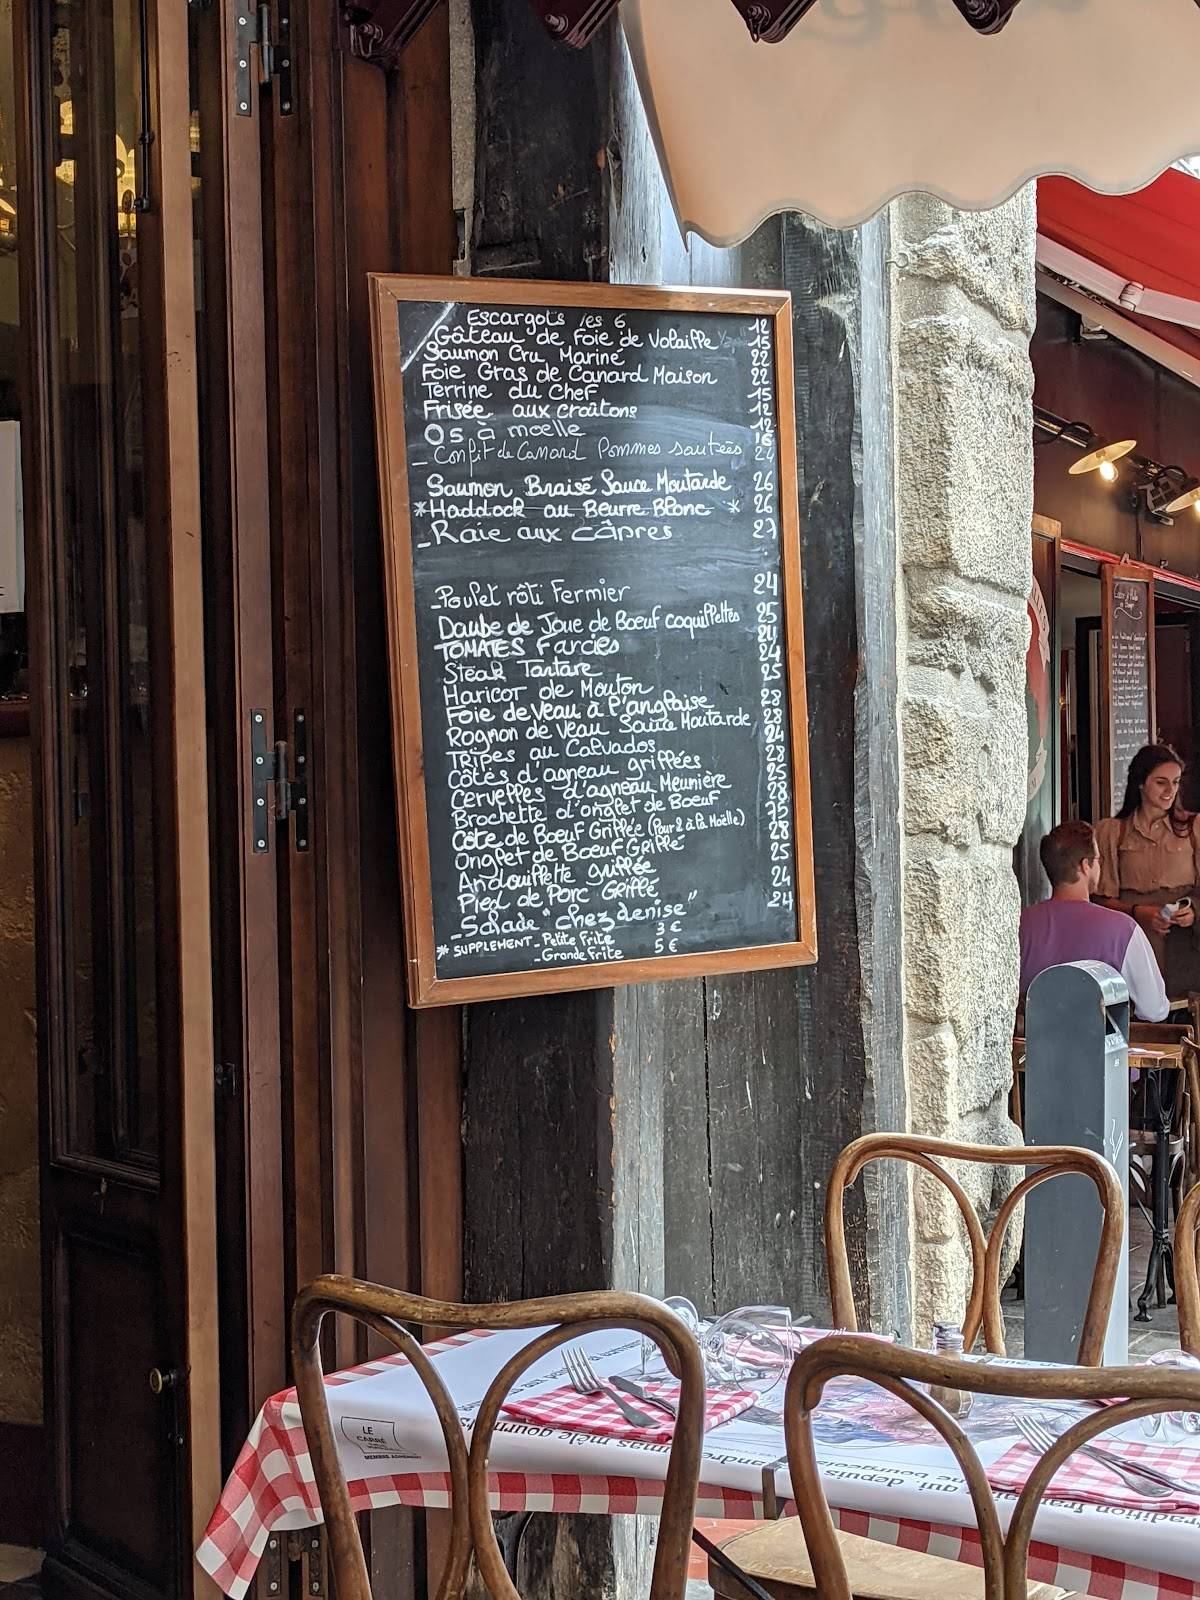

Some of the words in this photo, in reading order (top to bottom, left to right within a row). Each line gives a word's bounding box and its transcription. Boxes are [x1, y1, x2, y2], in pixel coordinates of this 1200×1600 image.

[467, 309, 565, 335] Escargots
[614, 313, 626, 329] 6
[748, 318, 770, 334] 12
[434, 325, 525, 346] Gâteau
[536, 327, 565, 346] de
[574, 328, 614, 346] Foie
[619, 328, 644, 348] de
[748, 335, 771, 349] 15
[423, 341, 499, 361] Saumon
[509, 344, 546, 363] Cru
[559, 345, 626, 366] Mariné
[750, 350, 770, 367] 22
[422, 363, 466, 381] Foie
[477, 362, 528, 381] Gras
[536, 362, 562, 383] de
[568, 363, 650, 384] Canard
[653, 365, 718, 385] Maison
[750, 367, 770, 385] 22
[422, 381, 492, 399] Terrine
[508, 381, 542, 400] du
[747, 387, 772, 401] 15
[423, 400, 494, 420] Frisée
[512, 403, 550, 419] aux
[556, 398, 638, 419] croûtons
[749, 401, 773, 416] 12
[477, 421, 496, 440] à
[751, 418, 774, 433] 12
[497, 440, 514, 459] de
[517, 439, 587, 461] Canard
[598, 436, 661, 459] Pommes
[755, 446, 775, 463] 24
[426, 473, 513, 497] Saumon
[523, 474, 597, 497] Braisé
[601, 468, 653, 496] Sauce
[656, 467, 732, 494] Moutarde
[753, 471, 774, 492] 26
[543, 503, 575, 518] au
[583, 500, 649, 518] Beurre
[652, 496, 712, 517] Blanc
[753, 493, 773, 514] 26
[517, 527, 562, 542] aux
[507, 582, 544, 606] rôti
[551, 578, 630, 604] Fermier
[753, 571, 778, 596] 24
[756, 602, 779, 623] 25
[438, 613, 504, 640] Daube
[507, 612, 533, 636] de
[537, 612, 584, 635] Joue
[589, 608, 612, 632] de
[434, 637, 526, 661] TOMATES
[536, 633, 620, 656] Farcies
[759, 643, 781, 662] 24
[443, 660, 506, 684] Steak
[517, 656, 603, 678] Tartare
[760, 663, 783, 681] 25
[539, 679, 574, 700] de
[581, 673, 654, 699] Mouton
[760, 688, 781, 707] 28
[446, 705, 495, 727] Foie
[503, 702, 531, 722] de
[763, 708, 783, 725] 28
[446, 726, 518, 754] Rognon
[525, 720, 552, 740] de
[619, 714, 677, 733] Sauce
[681, 707, 750, 730] Moutarde
[764, 725, 784, 744] 24
[529, 746, 560, 760] au
[565, 735, 656, 757] Calvados
[766, 744, 785, 762] 28
[448, 767, 509, 789] Côtes
[767, 763, 787, 781] 25
[451, 783, 546, 810] Cervelles
[659, 771, 732, 793] Meunière
[767, 781, 787, 801] 28
[451, 802, 547, 829] Brochette
[643, 796, 666, 813] de
[452, 828, 504, 851] Côte
[505, 825, 529, 846] de
[768, 820, 789, 840] 28
[454, 847, 530, 879] Onglet
[532, 845, 558, 863] de
[771, 842, 791, 861] 25
[771, 865, 791, 887] 24
[457, 890, 511, 914] Pied
[517, 887, 543, 908] de
[547, 883, 590, 906] Porc
[767, 891, 793, 911] 24
[453, 935, 533, 958] SUPPLEMENT
[362, 1426, 374, 1435] LE
[559, 1431, 611, 1447] mêle
[824, 1469, 904, 1488] depuis
